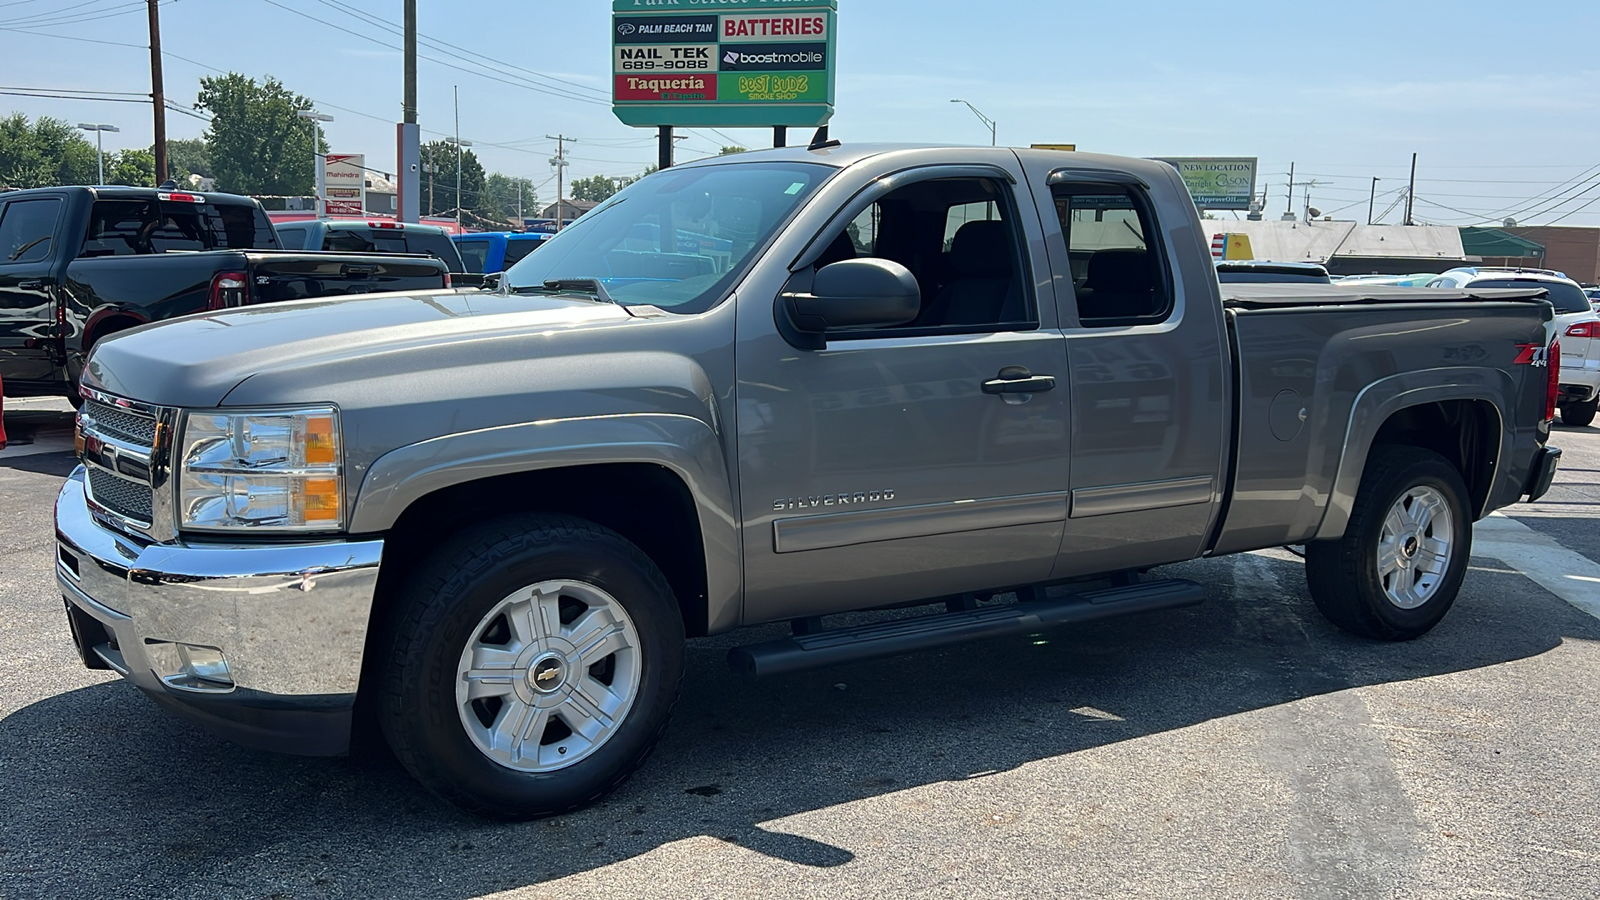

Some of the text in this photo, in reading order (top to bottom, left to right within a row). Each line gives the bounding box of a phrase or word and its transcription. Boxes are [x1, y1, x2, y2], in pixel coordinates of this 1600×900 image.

[639, 24, 712, 33] PALM BEACH TAN
[725, 18, 823, 36] BATTERIES
[621, 48, 709, 59] NAIL TEK
[623, 60, 708, 69] 689-9088
[772, 75, 808, 92] BUDZ
[1186, 180, 1211, 188] Enright
[1513, 343, 1547, 363] Z71
[774, 489, 894, 510] SILVERADO
